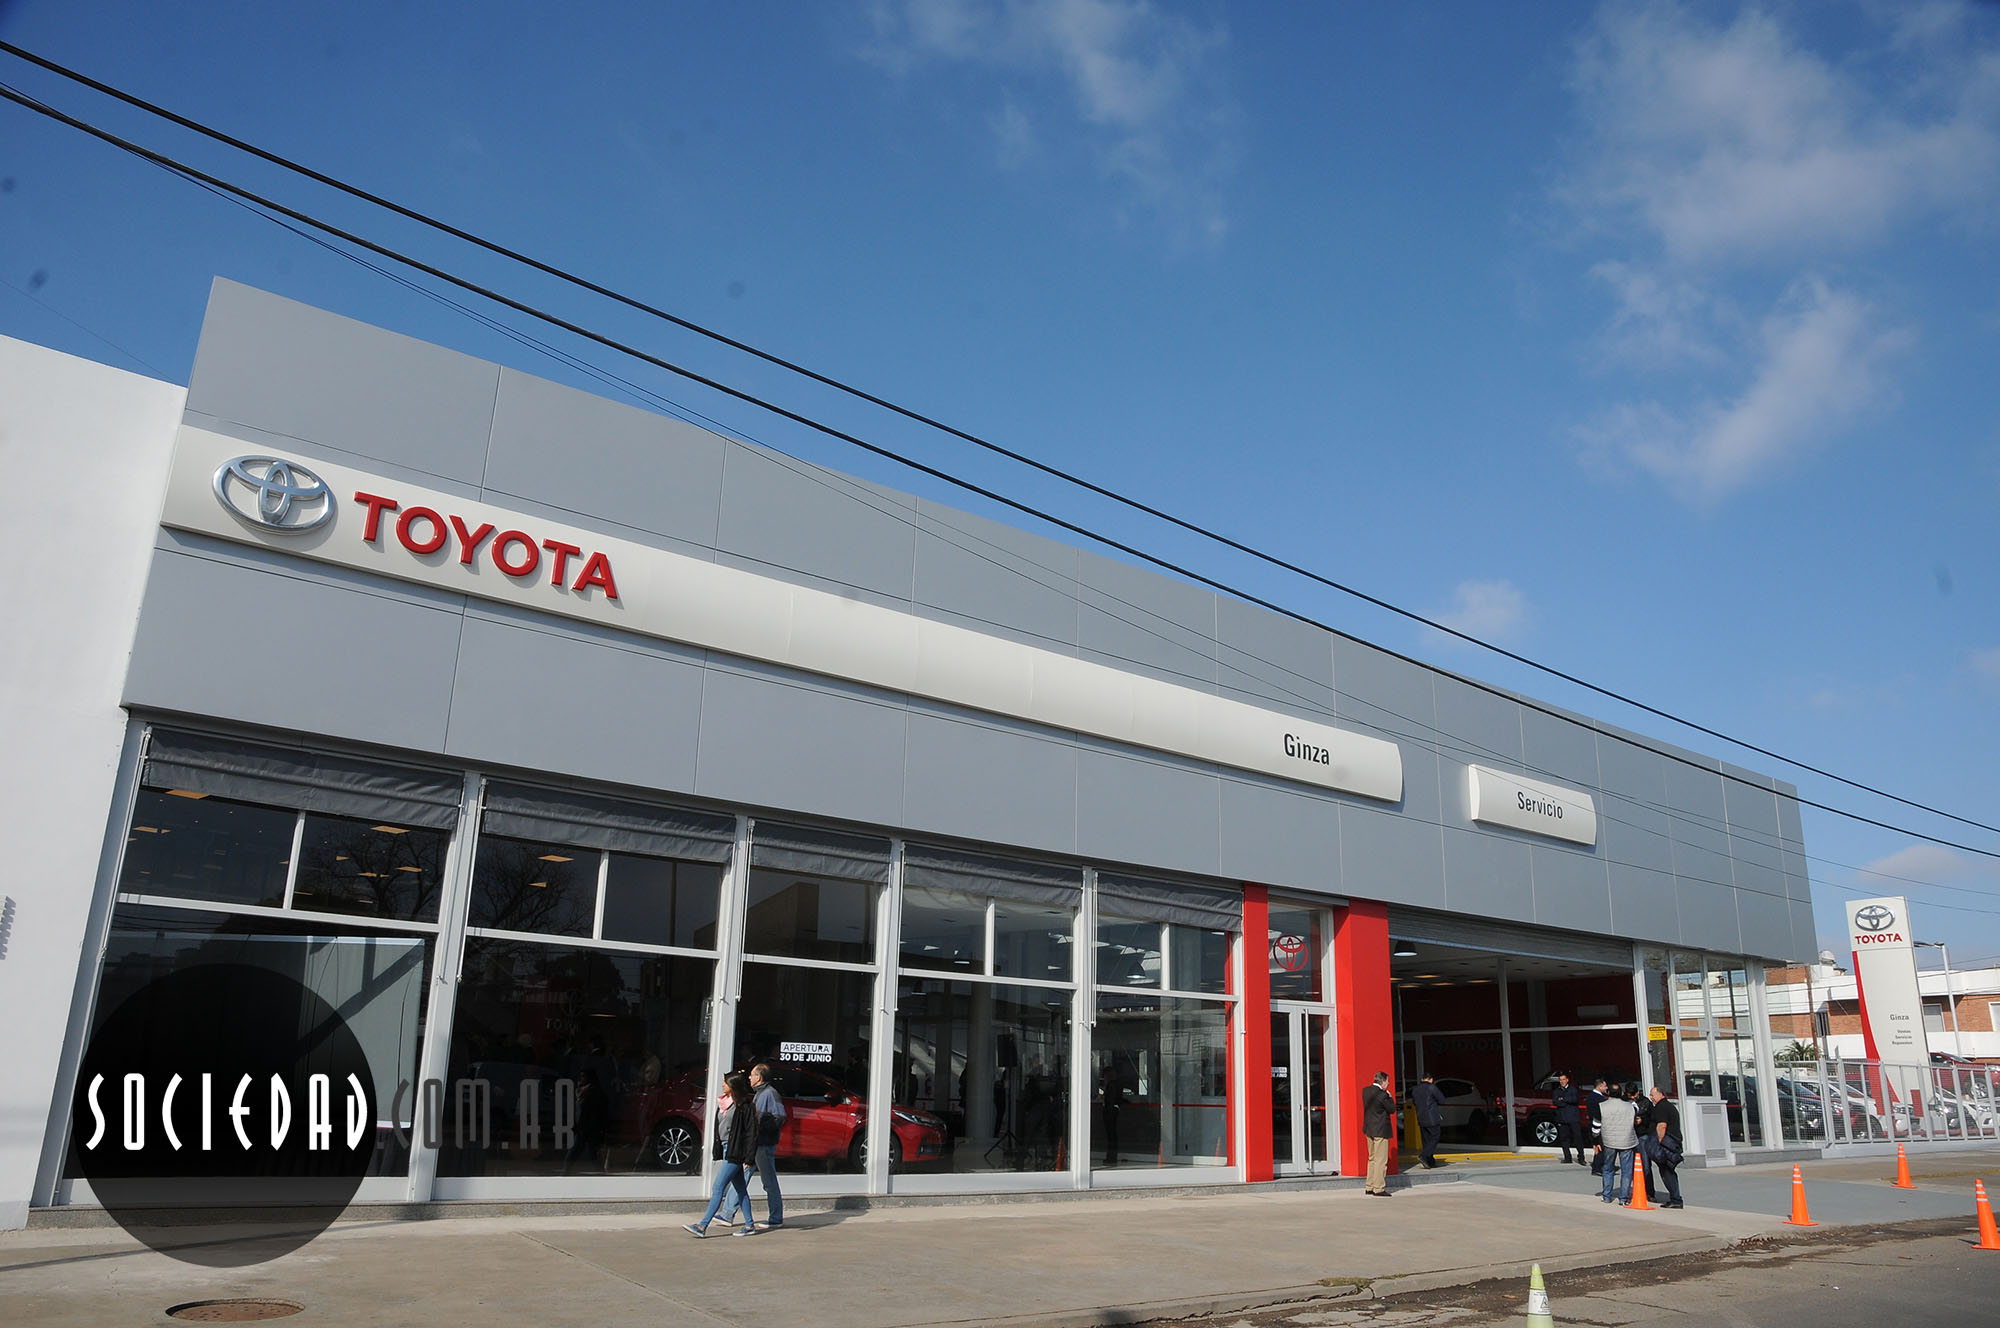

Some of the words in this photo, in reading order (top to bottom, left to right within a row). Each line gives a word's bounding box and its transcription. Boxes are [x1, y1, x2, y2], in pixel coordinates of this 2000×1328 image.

[354, 491, 619, 600] TOYOTA
[1283, 733, 1330, 765] Ginza
[1517, 791, 1564, 819] Servicio
[1855, 932, 1902, 945] TOYOTA
[1890, 1013, 1910, 1021] Ginza
[783, 1043, 830, 1053] APERTURA
[780, 1053, 791, 1061] 30
[792, 1053, 805, 1062] DE
[806, 1054, 832, 1063] JUNIO
